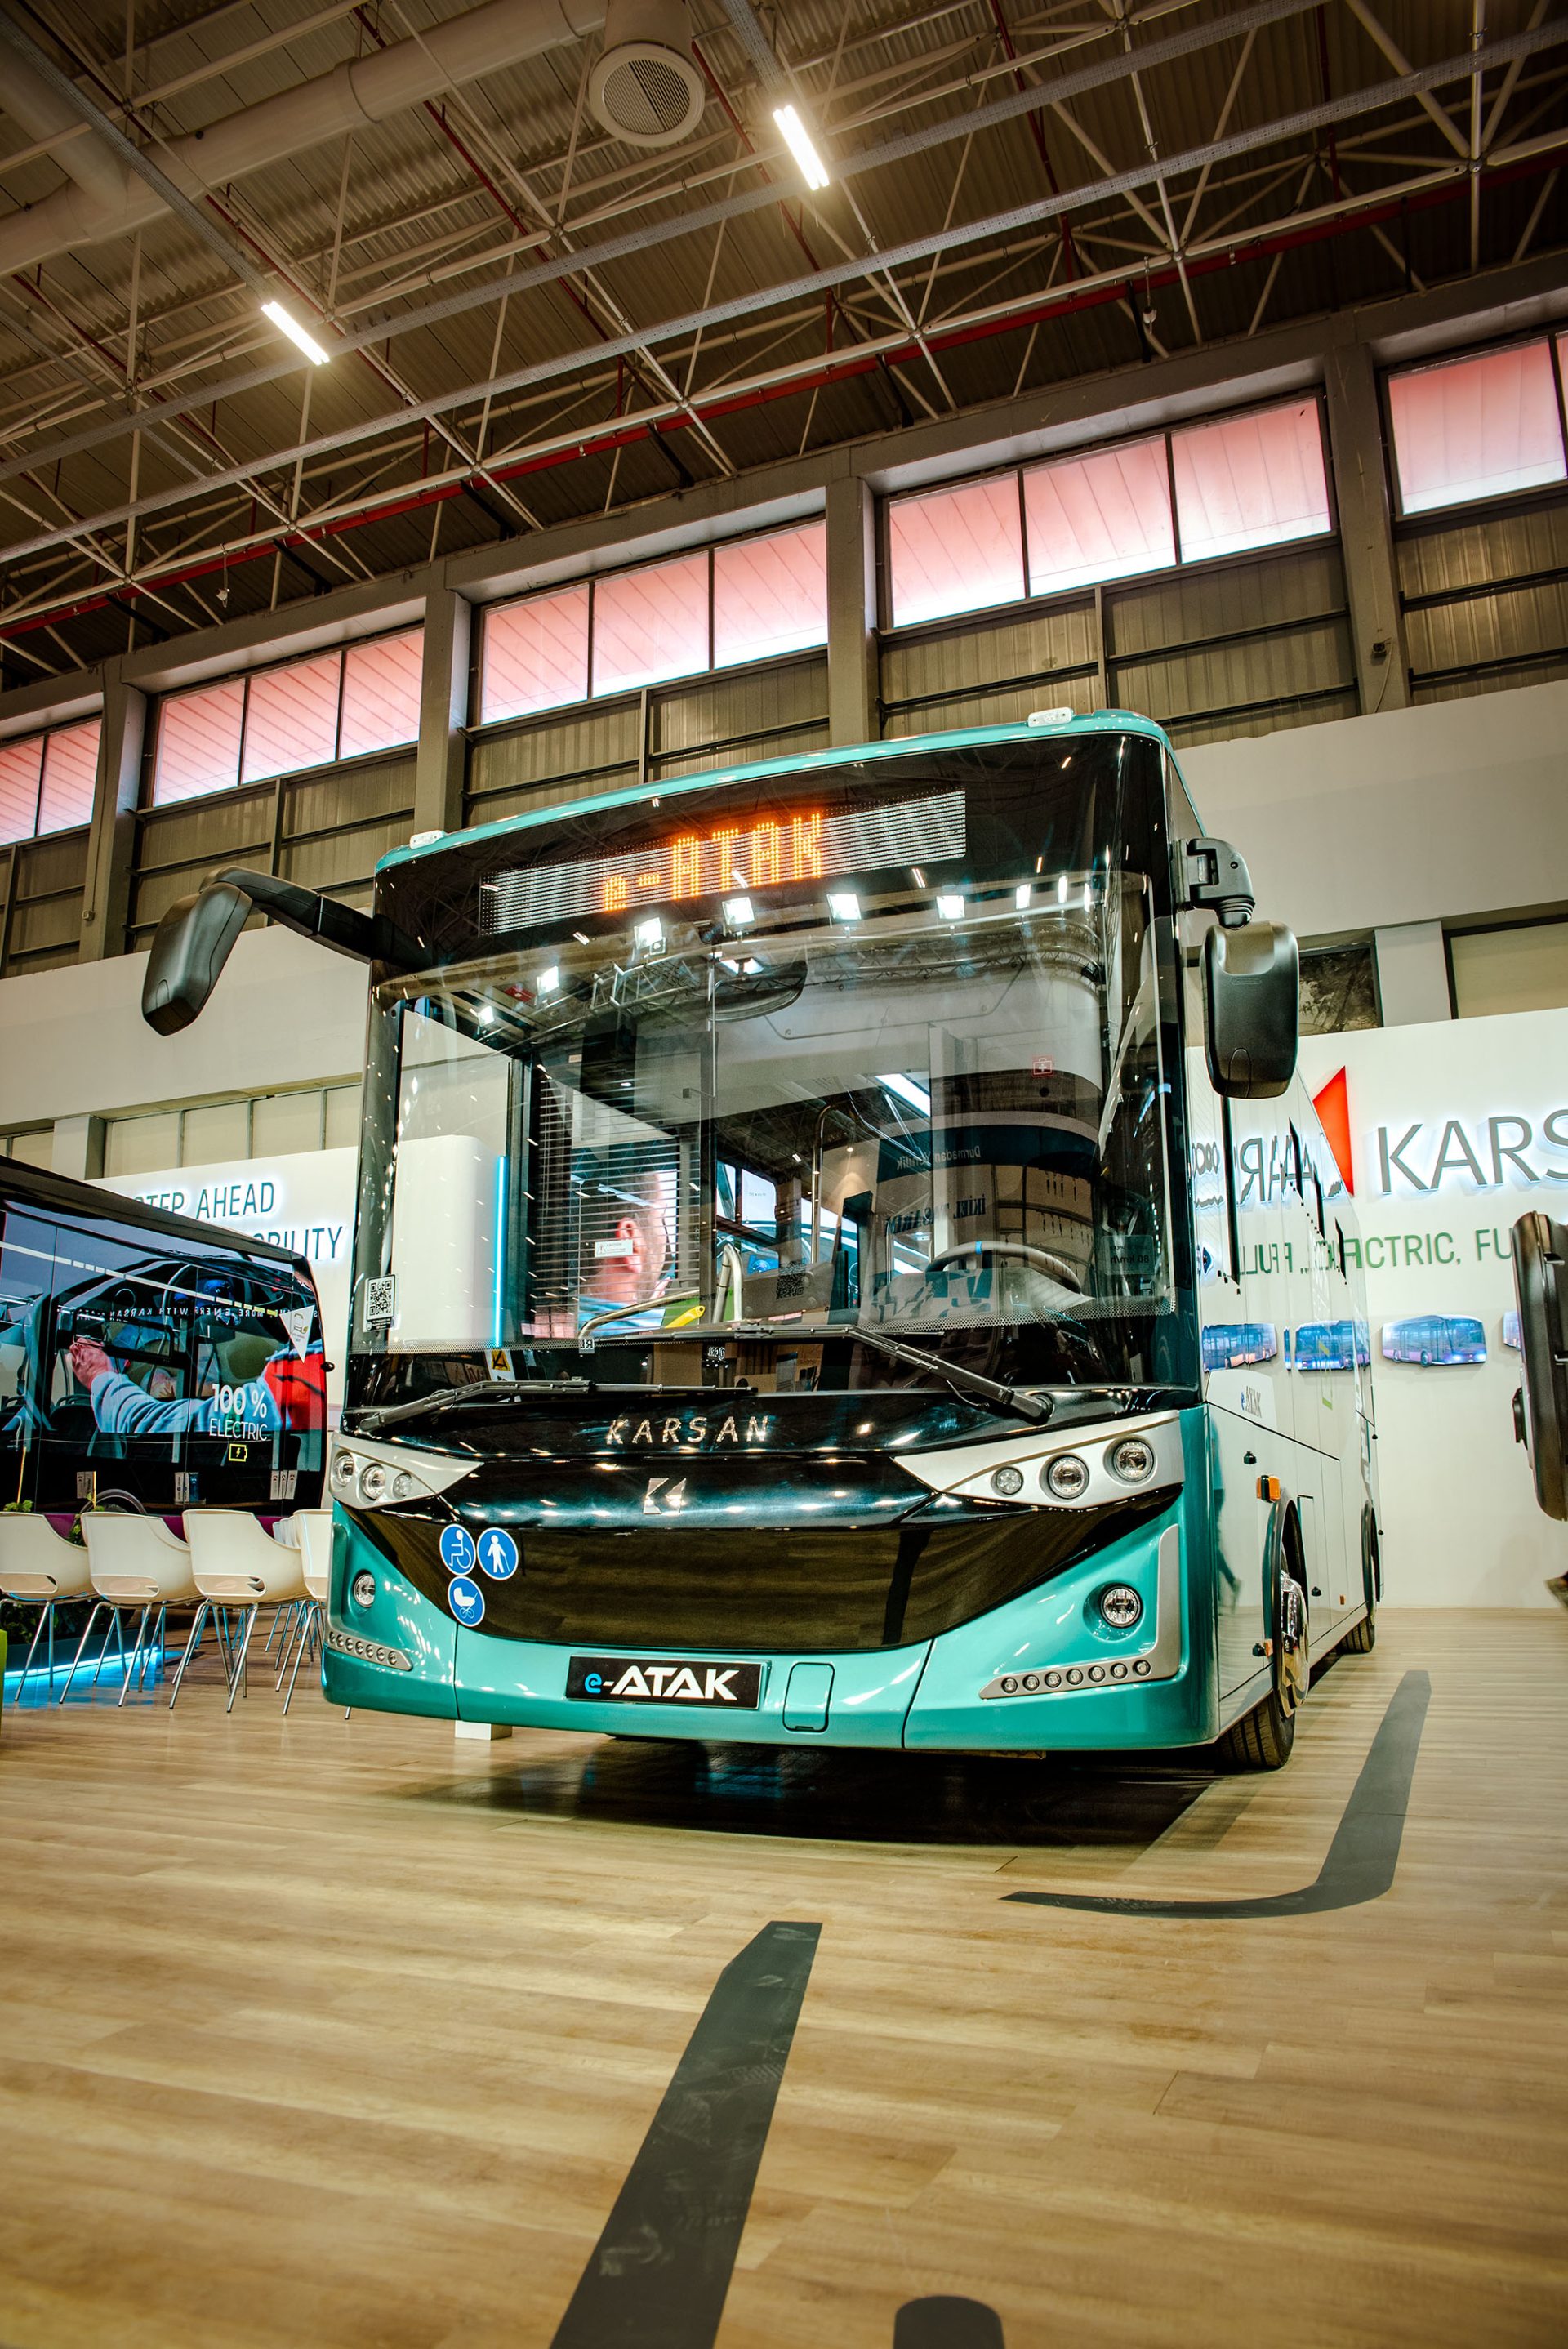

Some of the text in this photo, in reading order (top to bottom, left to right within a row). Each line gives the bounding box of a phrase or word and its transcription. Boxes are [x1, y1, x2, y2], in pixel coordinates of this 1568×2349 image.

[1378, 1109, 1568, 1193] KARS
[134, 1182, 274, 1219] TEP AHEAD
[1365, 1232, 1461, 1268] CTRIC,
[212, 1384, 246, 1415] 100
[209, 1418, 268, 1441] ELECTRIC
[606, 1415, 768, 1445] KARSAN
[584, 1665, 740, 1700] e-ATAK
